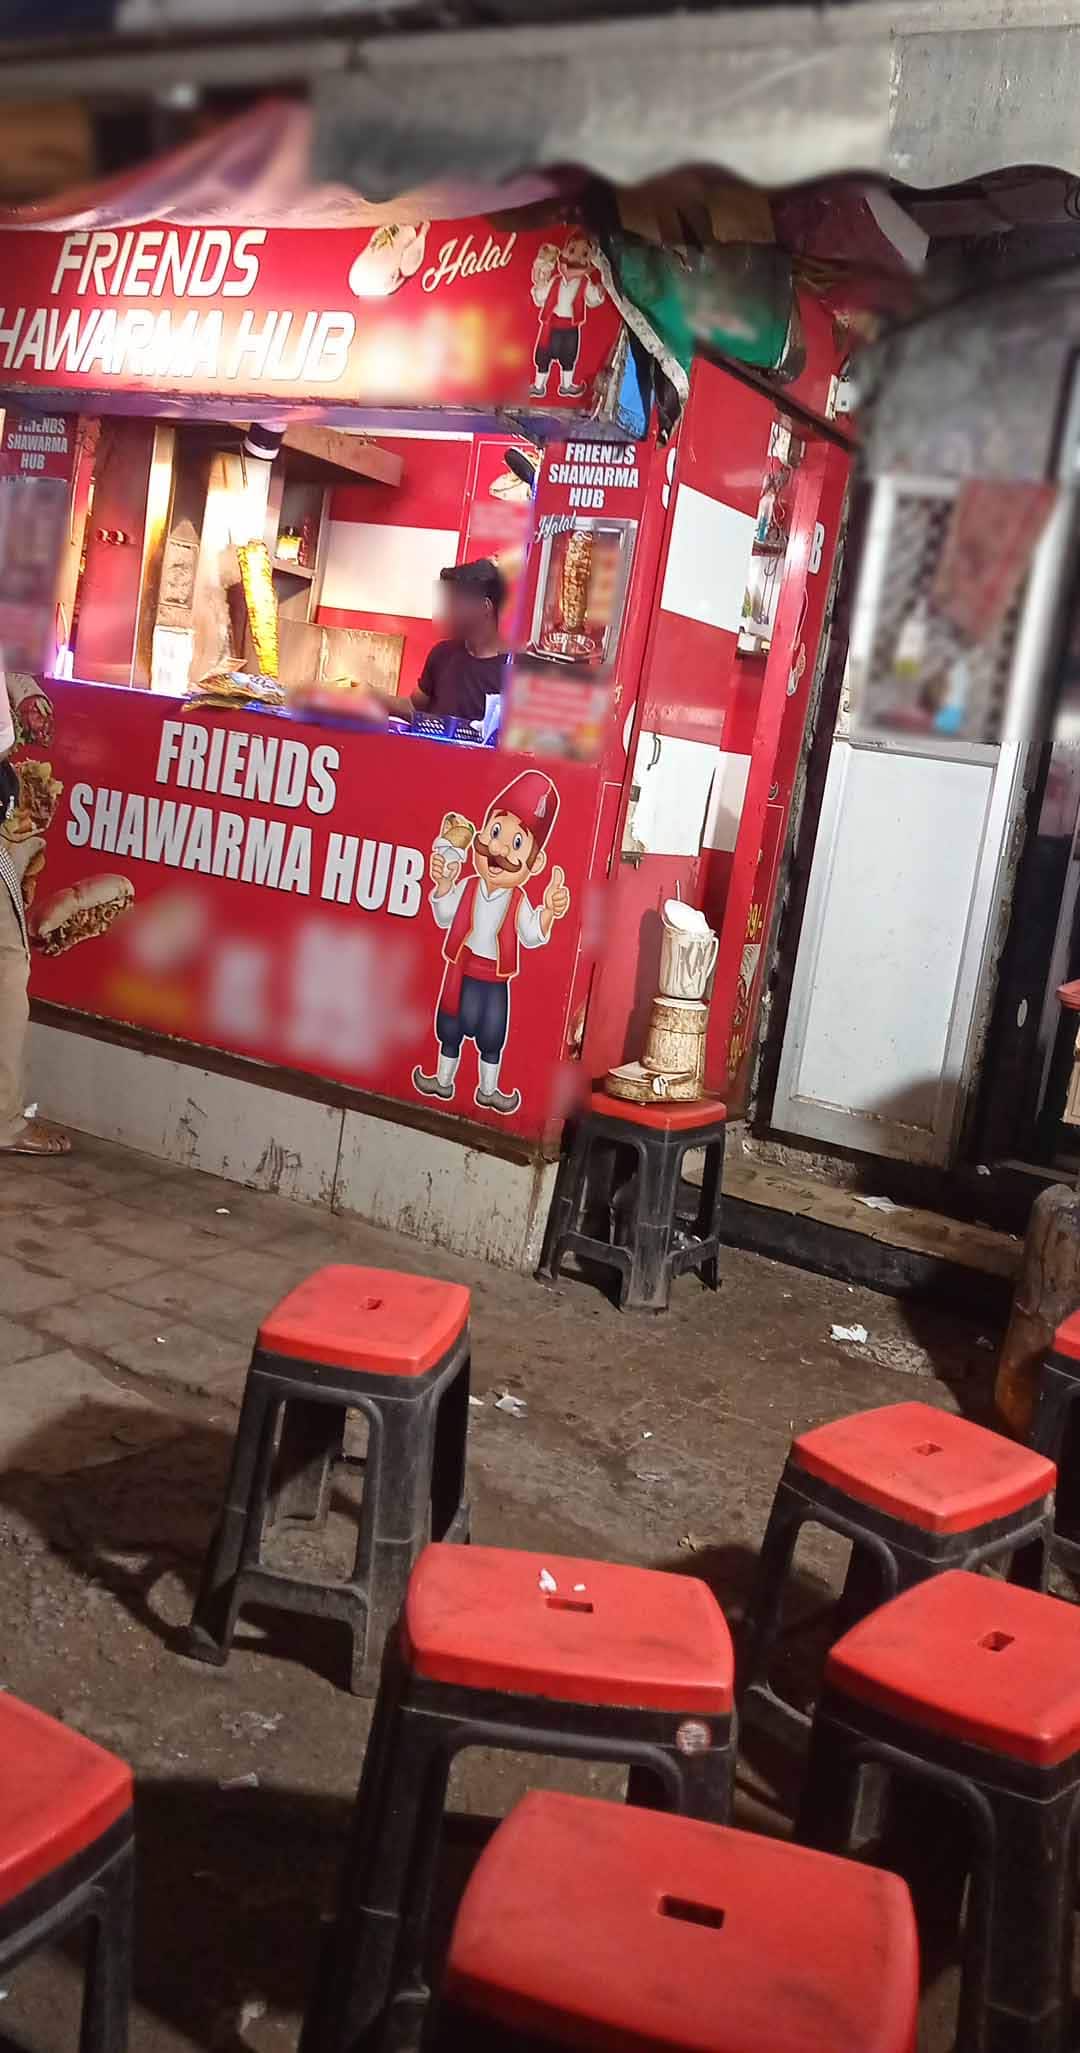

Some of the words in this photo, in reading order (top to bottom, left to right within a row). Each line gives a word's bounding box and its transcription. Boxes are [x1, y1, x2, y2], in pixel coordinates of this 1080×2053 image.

[50, 229, 268, 297] FRIENDS
[422, 231, 517, 292] Halal
[226, 309, 356, 383] HUB
[7, 433, 68, 453] SHAWARMA
[20, 452, 46, 470] HUB
[548, 463, 639, 489] SHAWARMA
[568, 487, 606, 509] HUB
[534, 509, 577, 544] Halal
[155, 719, 341, 815] FRIENDS
[66, 782, 313, 895] SHAWARMA
[320, 831, 425, 919] HUB
